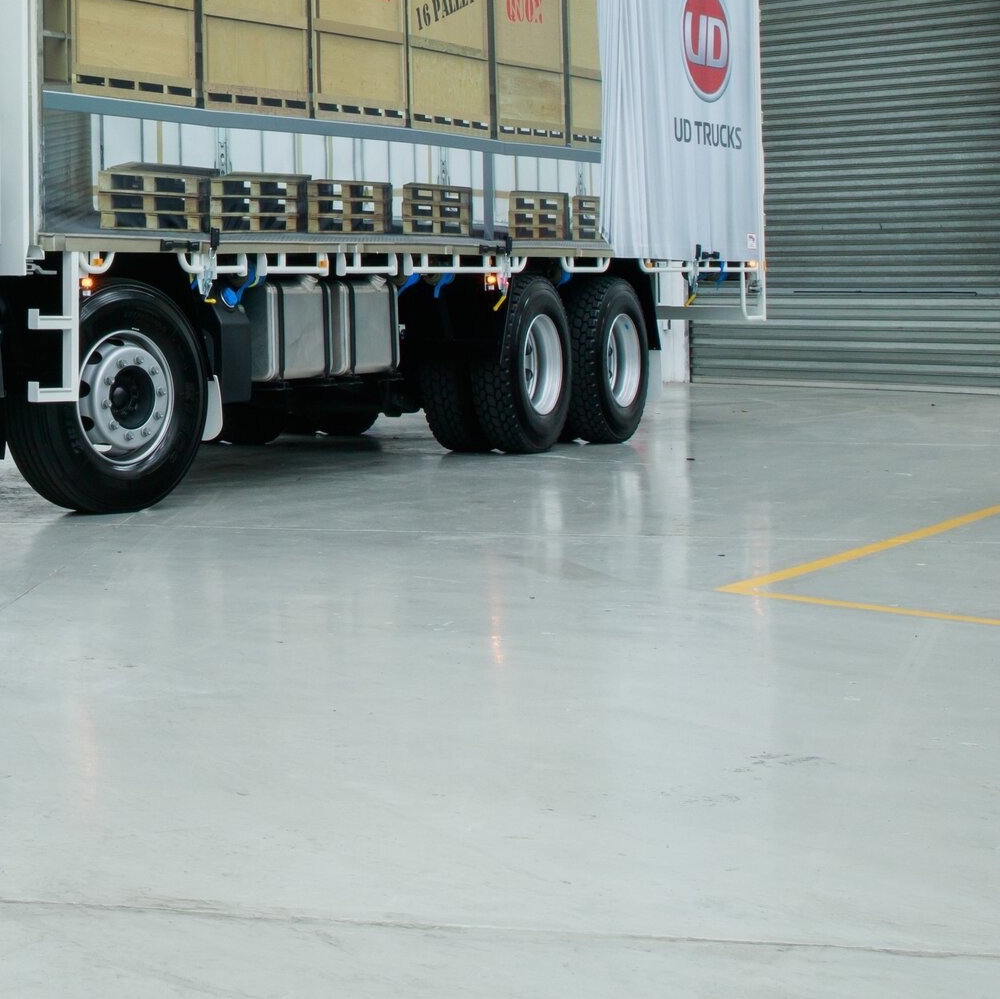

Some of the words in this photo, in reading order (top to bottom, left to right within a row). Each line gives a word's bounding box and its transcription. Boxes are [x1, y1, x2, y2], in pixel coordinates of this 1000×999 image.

[415, 3, 431, 31] 16
[684, 10, 729, 69] UD
[673, 116, 692, 143] UD
[694, 121, 743, 150] TRUCKS
